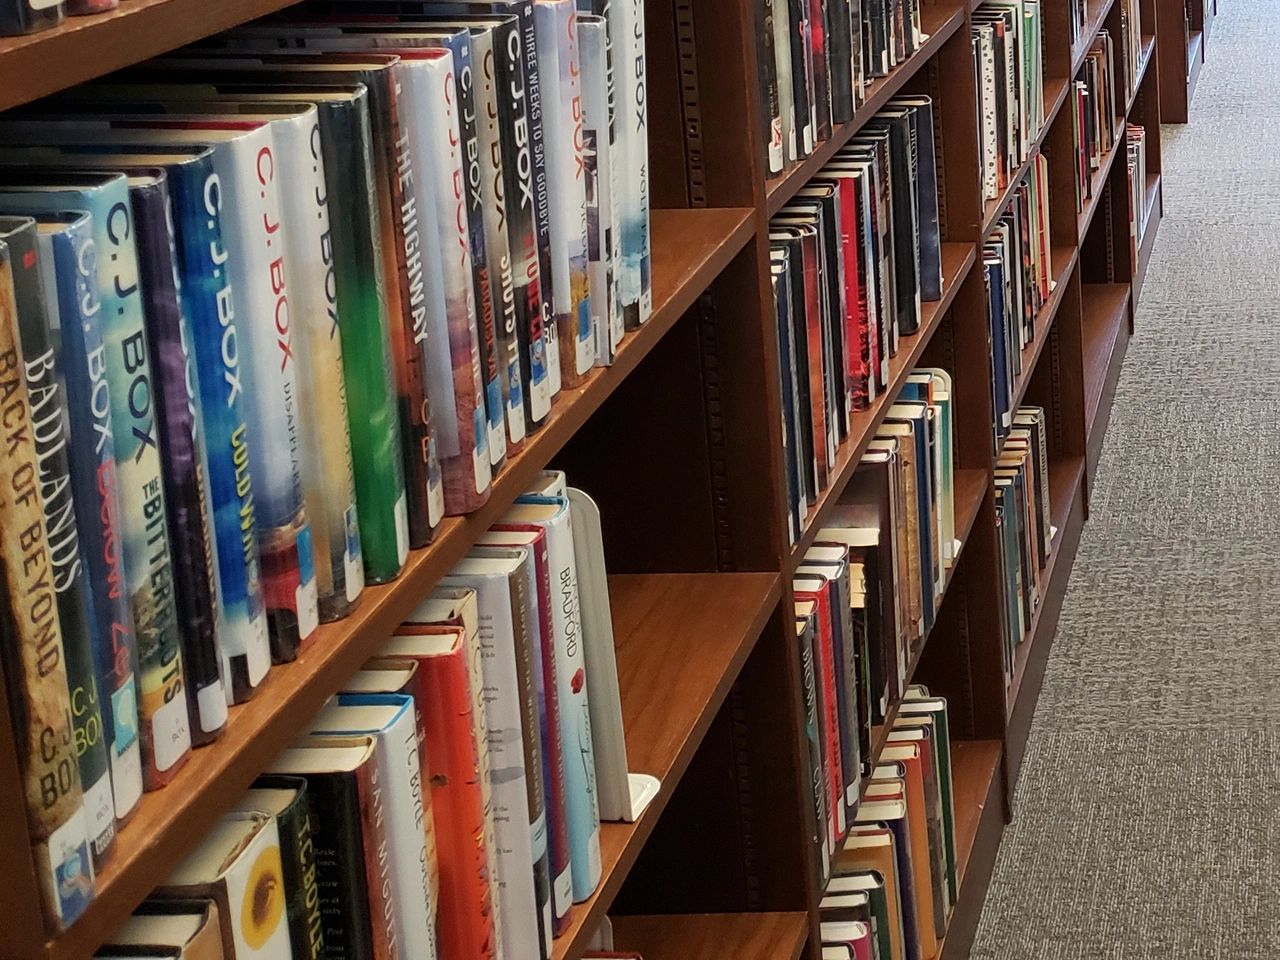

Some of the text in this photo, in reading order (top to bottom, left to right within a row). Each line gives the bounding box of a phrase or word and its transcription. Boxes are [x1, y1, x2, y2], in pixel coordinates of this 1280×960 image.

[460, 65, 485, 212] C.J. BOX
[483, 48, 506, 233] C.J. BOX
[507, 28, 534, 211] C.J. BOX
[524, 25, 548, 237] THREE WEEKS TO GOODBYE
[571, 96, 585, 181] BOX
[634, 55, 646, 133] BOX
[203, 173, 243, 409] C.J. BOX
[256, 145, 295, 374] C.J. BOX
[309, 122, 341, 341] C.J. BOX
[401, 196, 428, 346] HIGHWAY
[453, 168, 471, 268] BOX
[76, 238, 113, 456] C.J. BOX
[105, 200, 157, 465] C.J. BOX
[25, 345, 83, 595] BADLANDS
[231, 422, 252, 498] COLD
[18, 522, 62, 679] BEYOND
[142, 493, 183, 705] BITTERROOTS
[559, 566, 578, 659] BRADFORD
[371, 768, 398, 955] SAN MIGUEL
